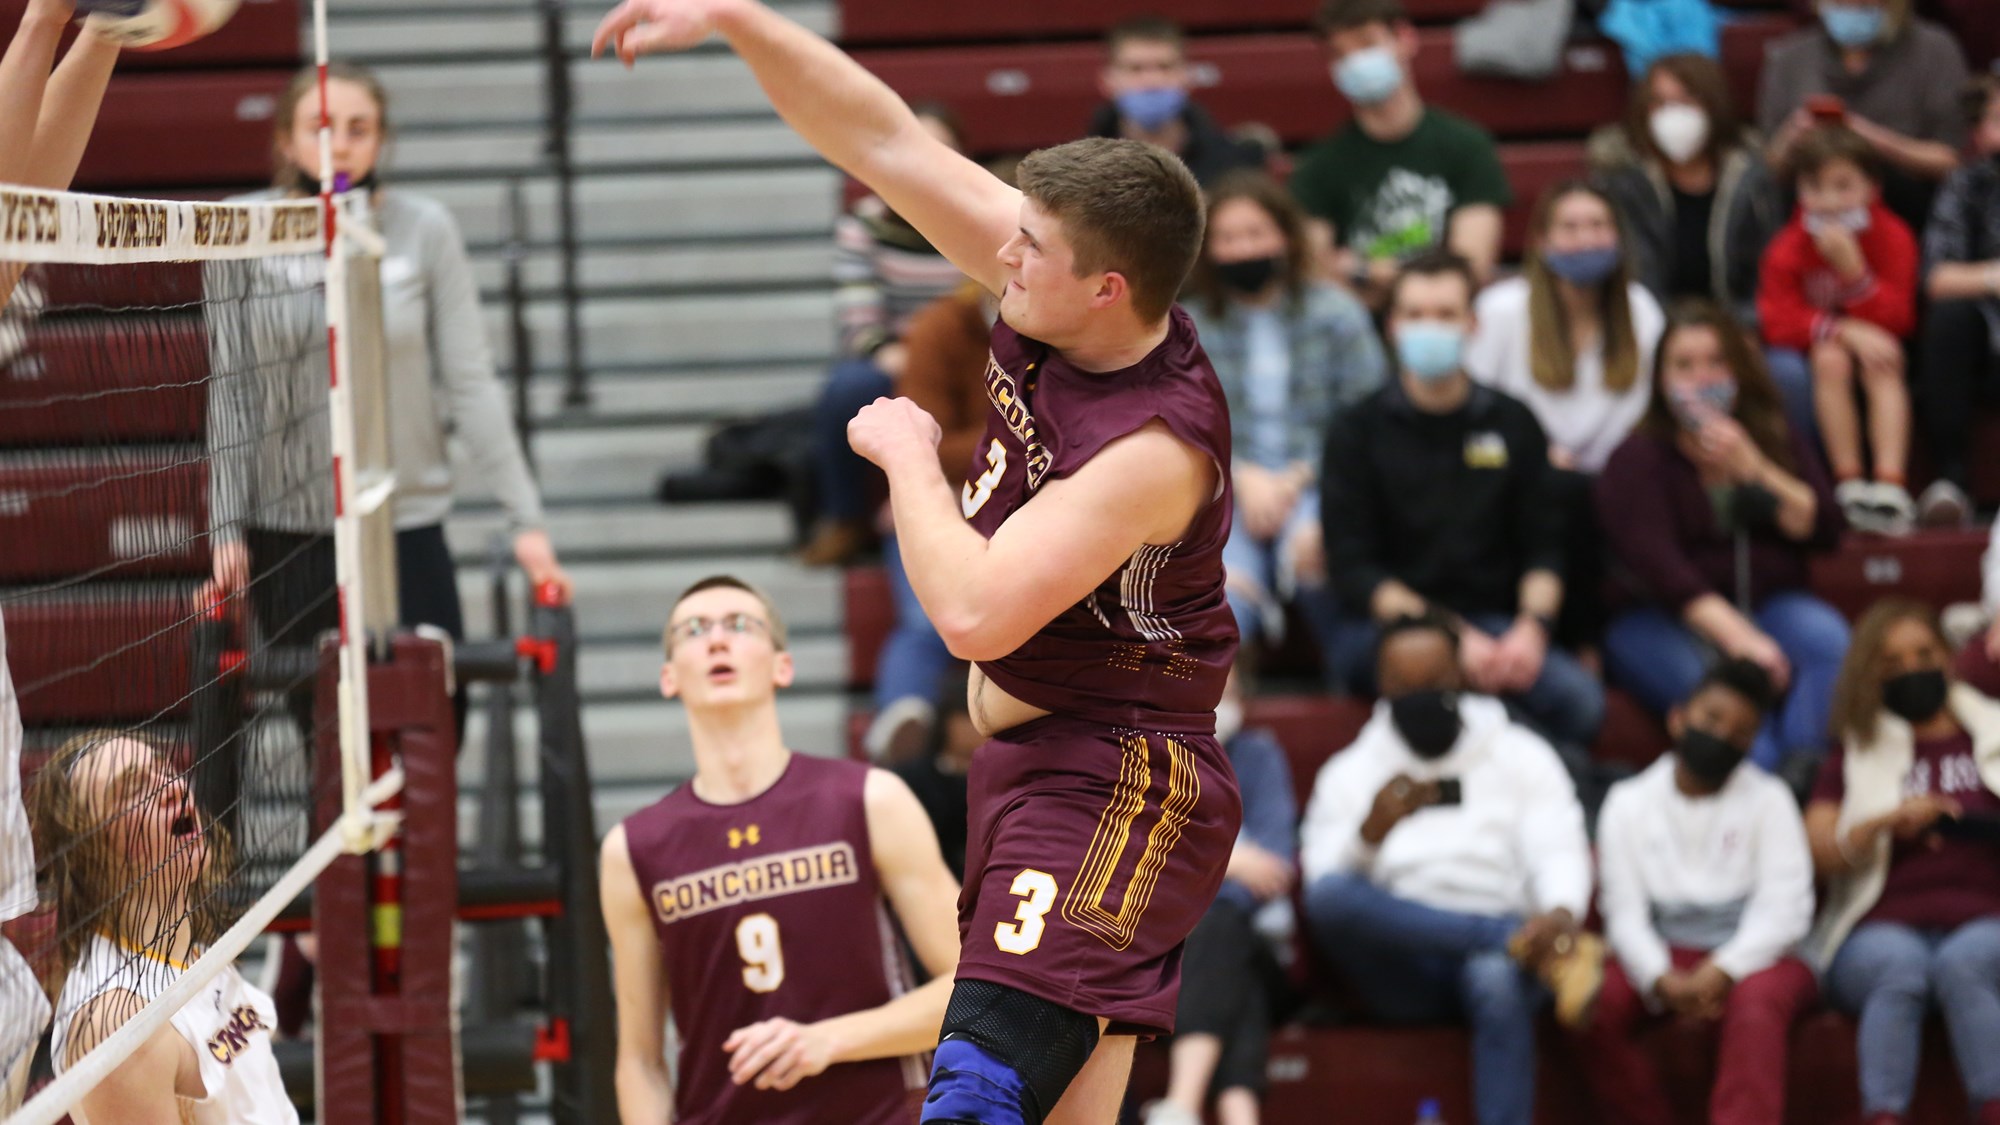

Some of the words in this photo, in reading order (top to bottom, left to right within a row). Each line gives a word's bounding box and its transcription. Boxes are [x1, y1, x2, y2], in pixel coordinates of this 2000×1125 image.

[961, 437, 1007, 520] 3
[653, 843, 857, 922] CONCORDIA
[993, 868, 1059, 956] 3
[735, 912, 785, 993] 9
